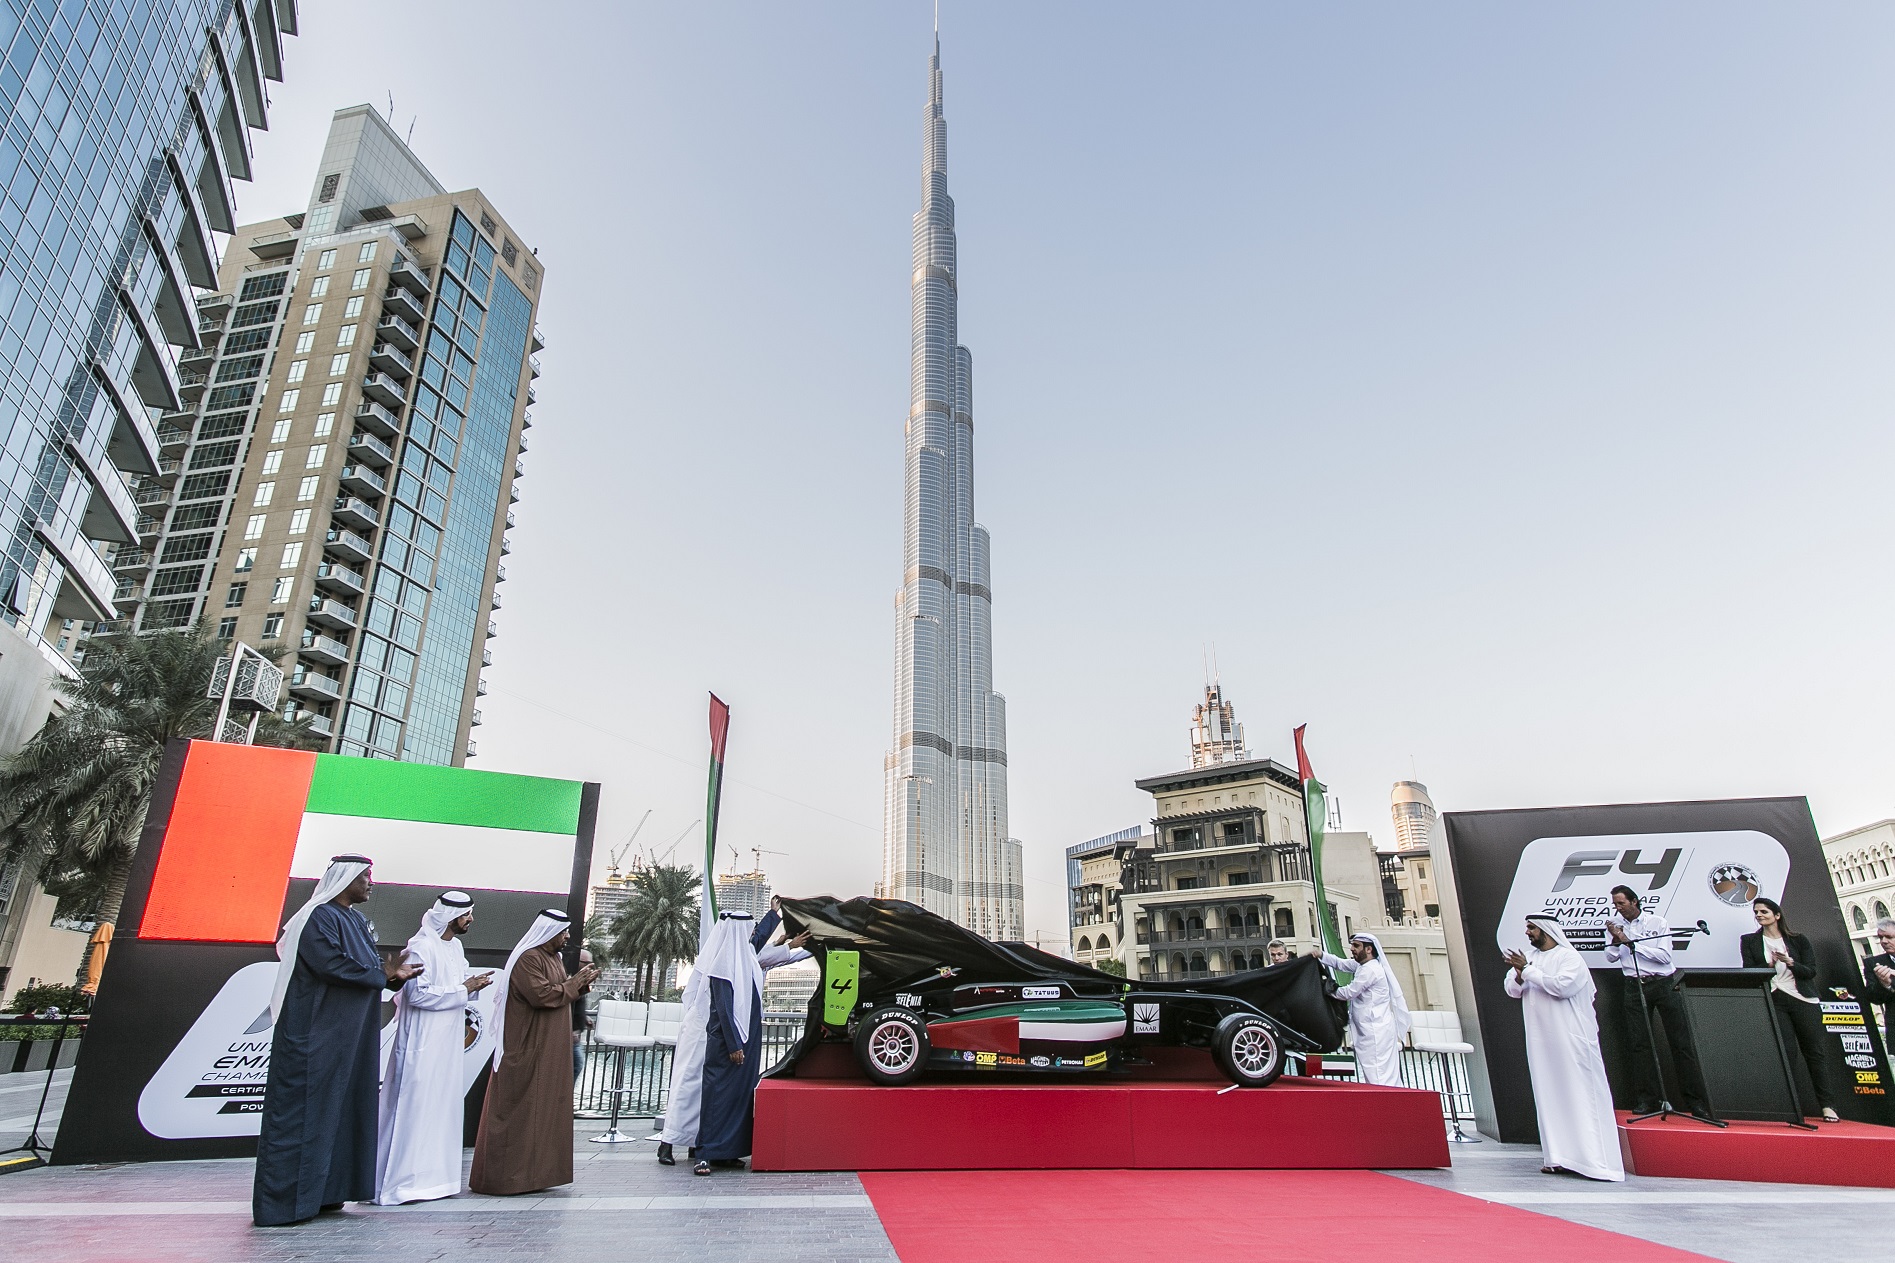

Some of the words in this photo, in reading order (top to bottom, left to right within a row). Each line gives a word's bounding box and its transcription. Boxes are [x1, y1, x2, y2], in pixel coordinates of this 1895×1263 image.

[1551, 848, 1683, 893] F4
[1545, 897, 1608, 906] UNITED
[1540, 906, 1656, 918] EMIRATS
[1558, 919, 1604, 927] AMPIO
[831, 979, 853, 995] 4
[881, 1011, 919, 1026] DUNLOP
[1244, 1019, 1272, 1030] DUNLOP
[228, 1042, 272, 1052] UNI
[213, 1055, 270, 1069] EMI
[976, 1053, 998, 1063] OMP
[1006, 1056, 1026, 1065] Beta
[201, 1072, 268, 1081] CHAMP
[1863, 1086, 1885, 1094] Beta
